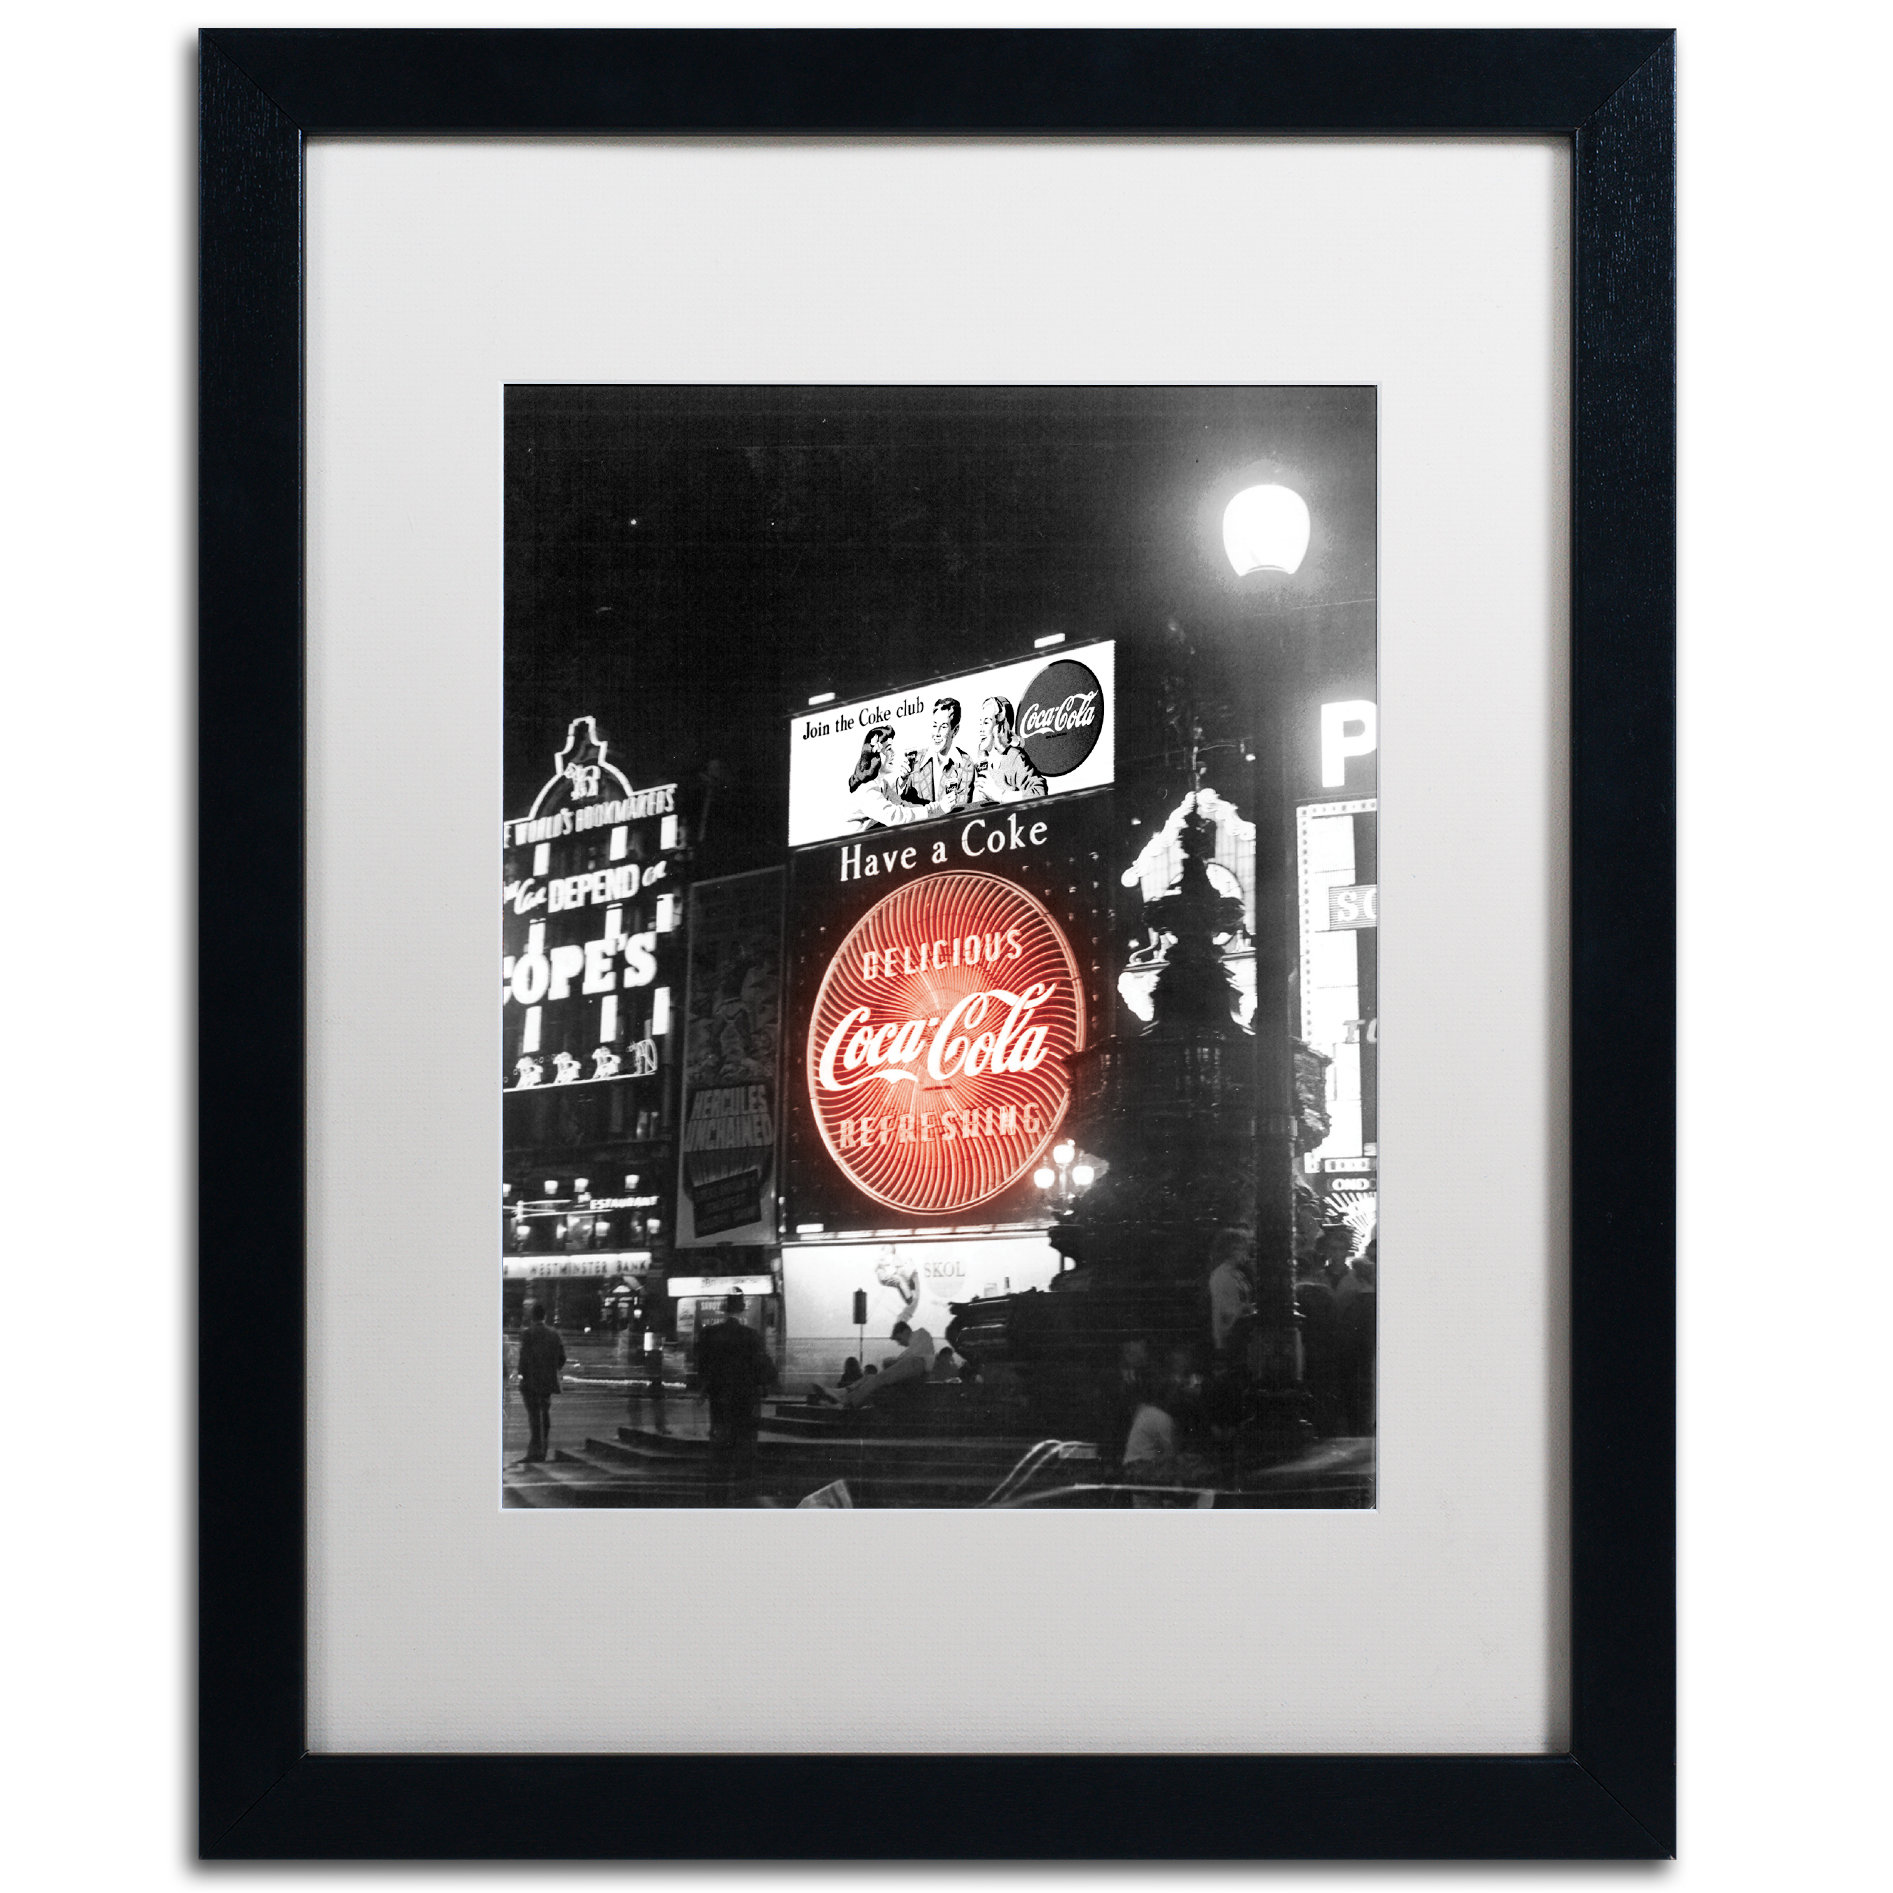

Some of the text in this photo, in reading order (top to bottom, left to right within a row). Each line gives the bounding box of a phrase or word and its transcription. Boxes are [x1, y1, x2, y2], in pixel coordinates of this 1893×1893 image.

[802, 696, 924, 740] Join the Coke club
[1020, 690, 1098, 738] Coca-Cola
[840, 813, 1048, 881] Have a Coke
[548, 864, 640, 913] DEPEND
[863, 929, 1023, 981] DELICIOUS
[819, 983, 1057, 1091] Coca-Cola
[839, 1102, 1040, 1149] REFRESHING
[616, 1259, 648, 1274] BANK
[924, 1261, 966, 1277] SKOL
